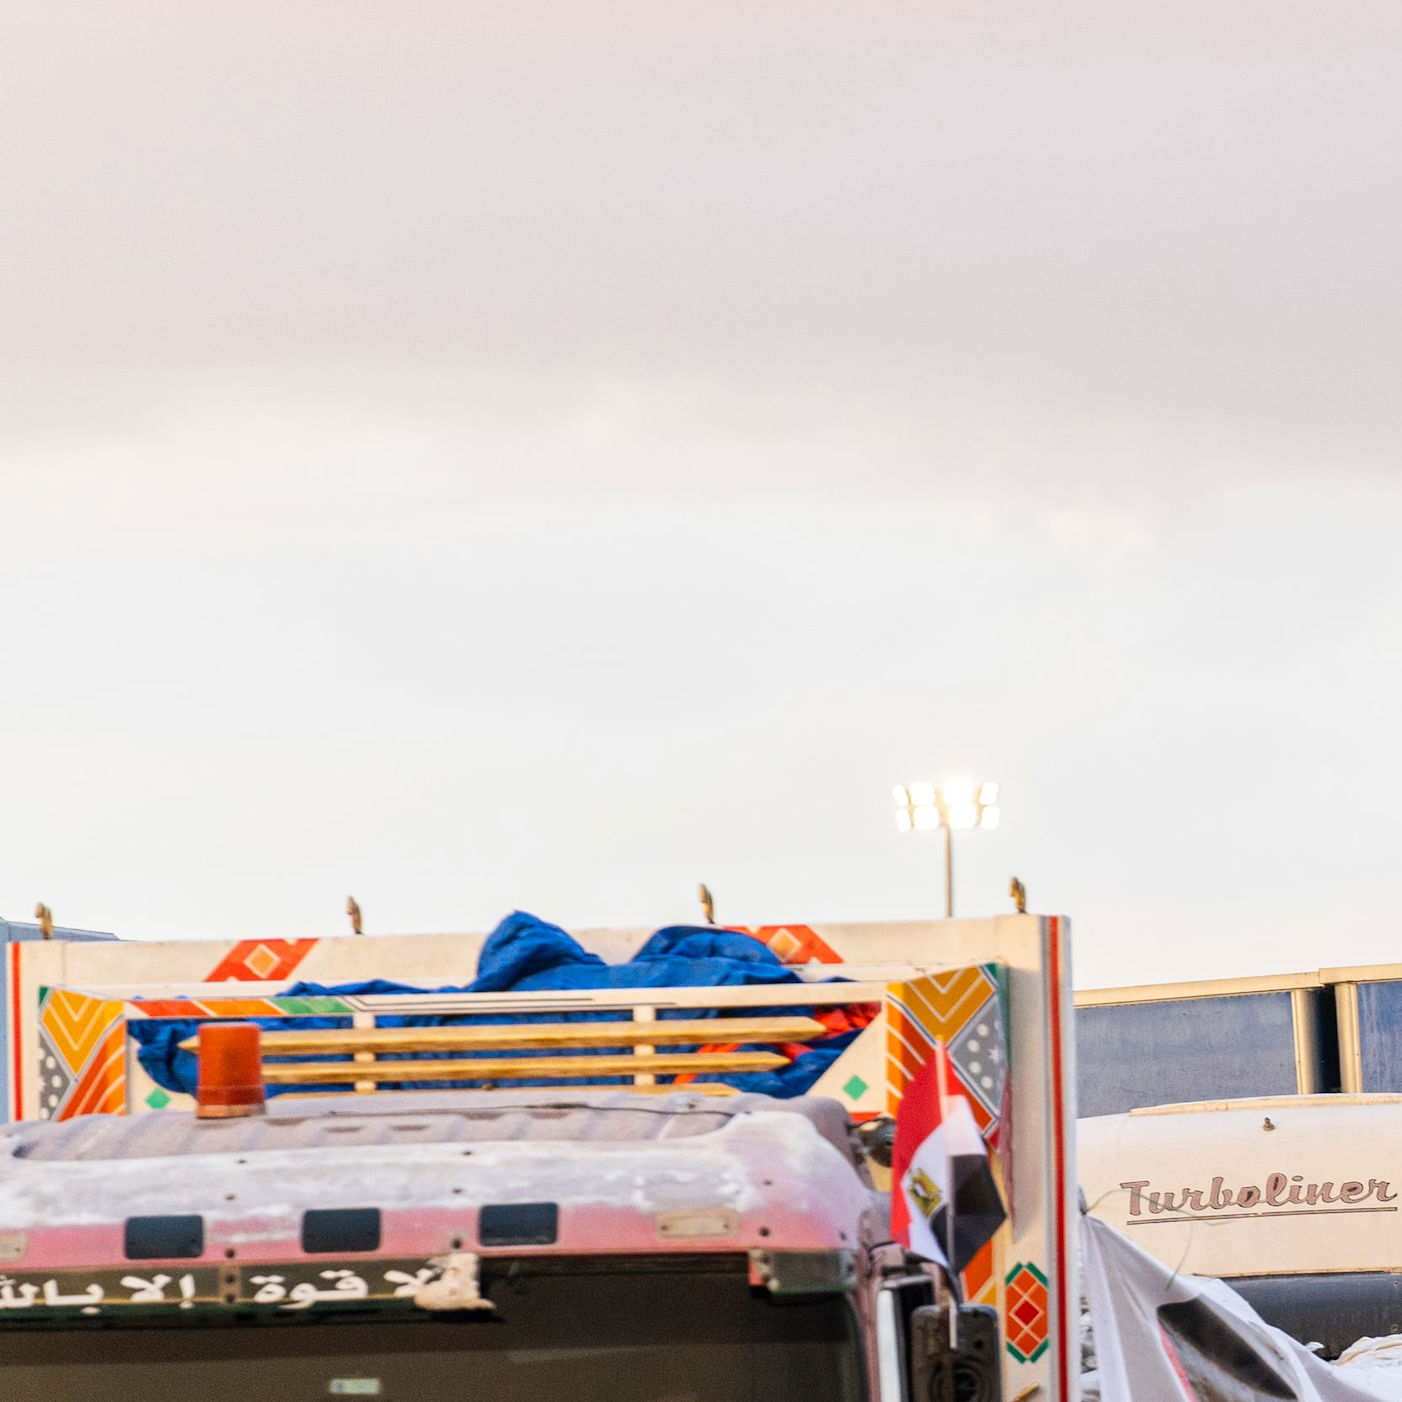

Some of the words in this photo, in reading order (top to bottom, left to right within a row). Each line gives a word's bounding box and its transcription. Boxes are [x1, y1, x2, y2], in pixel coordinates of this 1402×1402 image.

[1119, 1172, 1398, 1216] Turboliner
[0, 1274, 105, 1315] بالل
[119, 1272, 197, 1310] إلا
[249, 1269, 369, 1310] قوة
